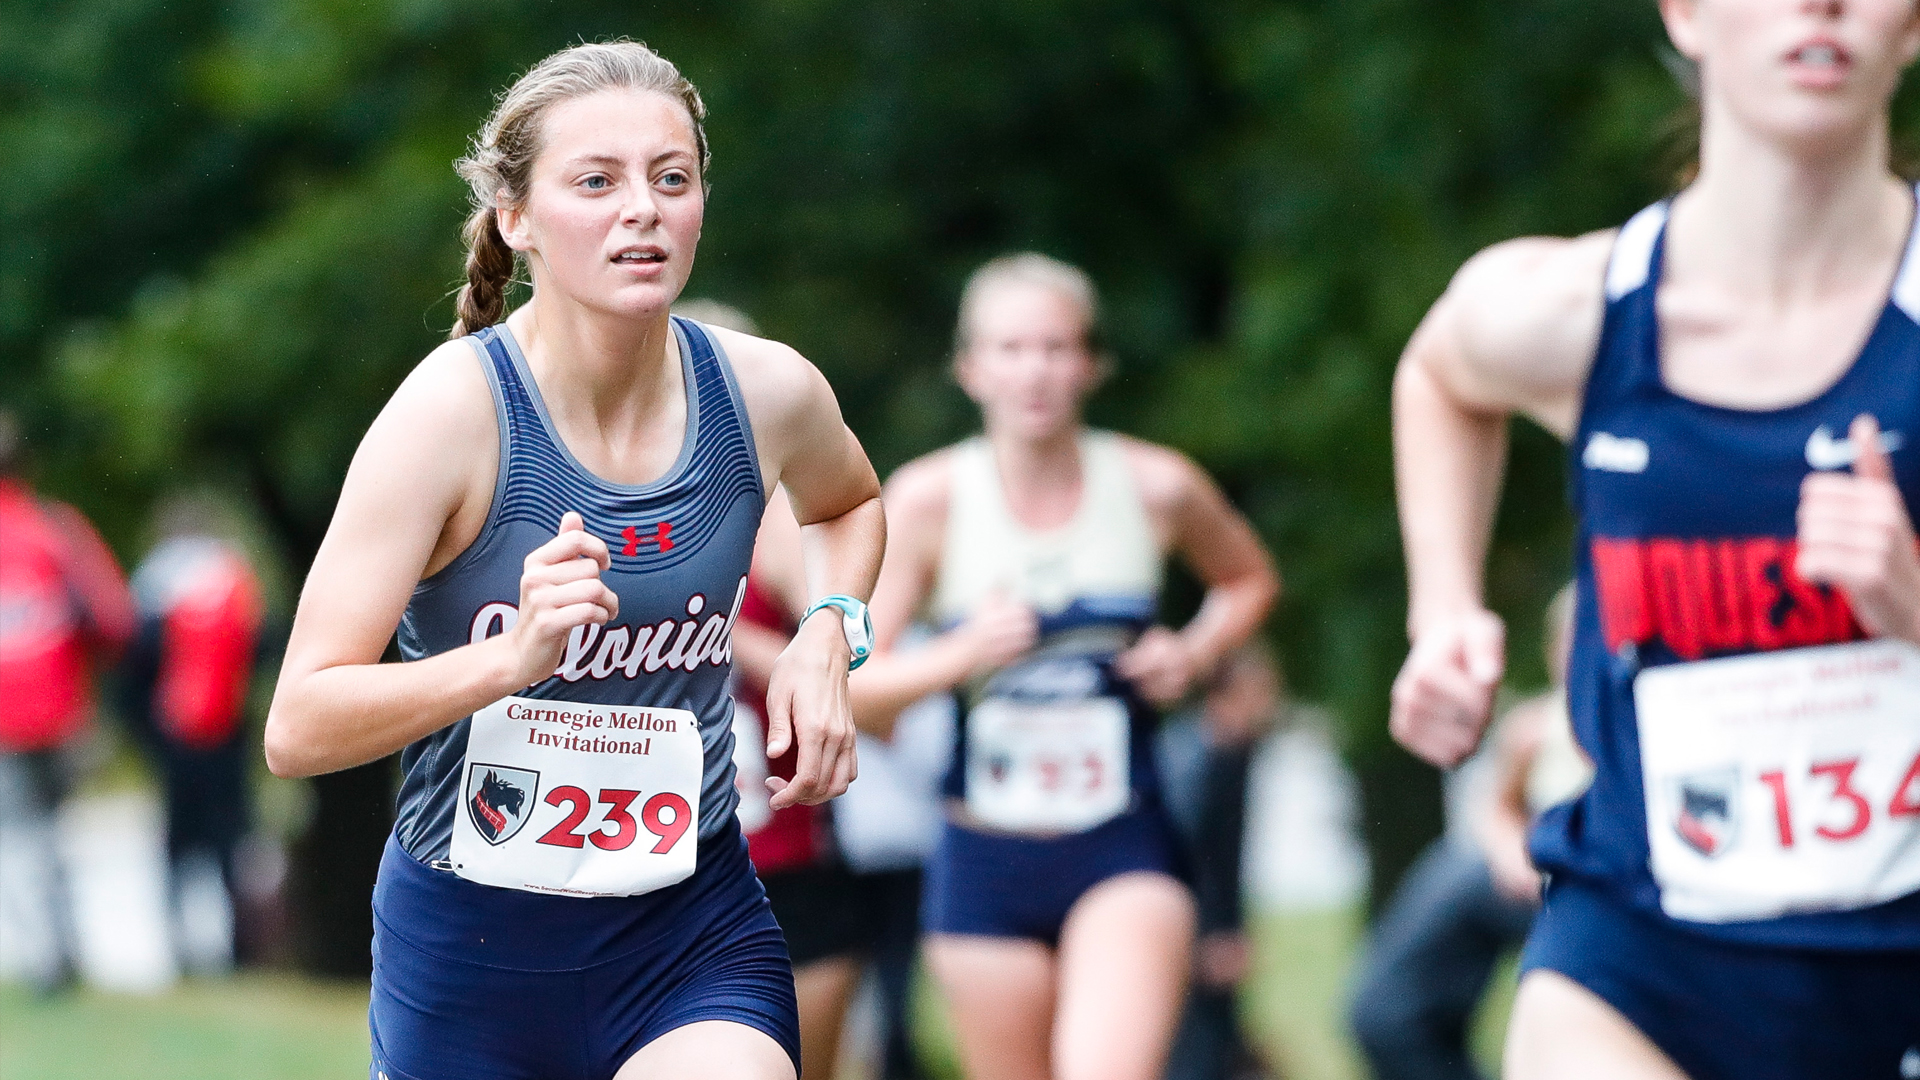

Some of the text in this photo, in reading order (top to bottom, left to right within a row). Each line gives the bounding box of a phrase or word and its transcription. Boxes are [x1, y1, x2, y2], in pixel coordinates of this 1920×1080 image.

[468, 574, 749, 687] lonial
[506, 703, 678, 733] Carnegie Mellon
[527, 727, 652, 756] Invitational
[535, 785, 692, 854] 239
